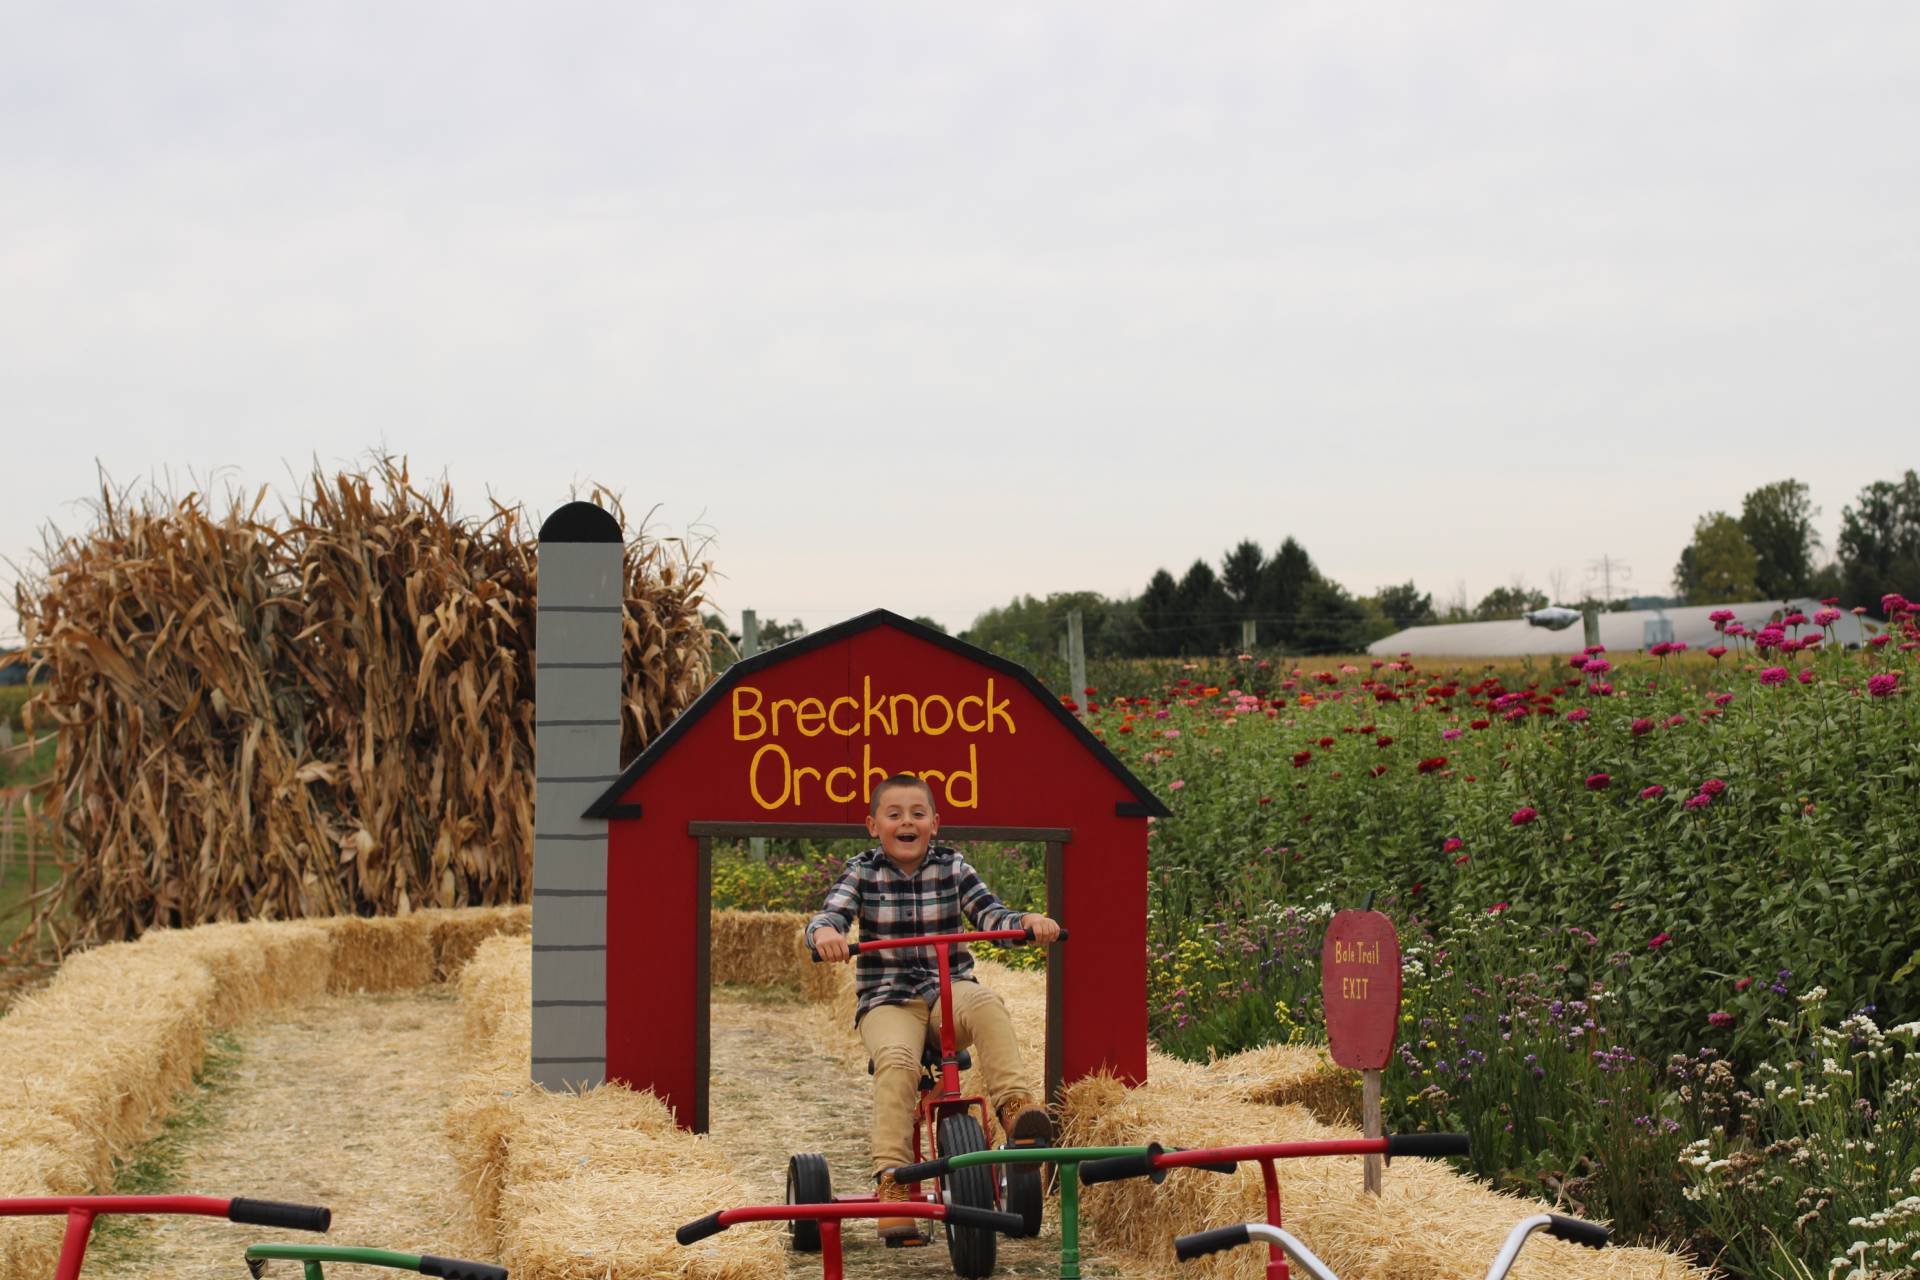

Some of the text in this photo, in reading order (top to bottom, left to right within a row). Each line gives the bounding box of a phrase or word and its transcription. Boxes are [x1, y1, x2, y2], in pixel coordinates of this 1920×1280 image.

[732, 675, 1016, 741] Brecknock
[750, 743, 978, 809] Orchrd
[1335, 940, 1379, 965] Bale Trail
[1343, 977, 1369, 1000] EXIT
